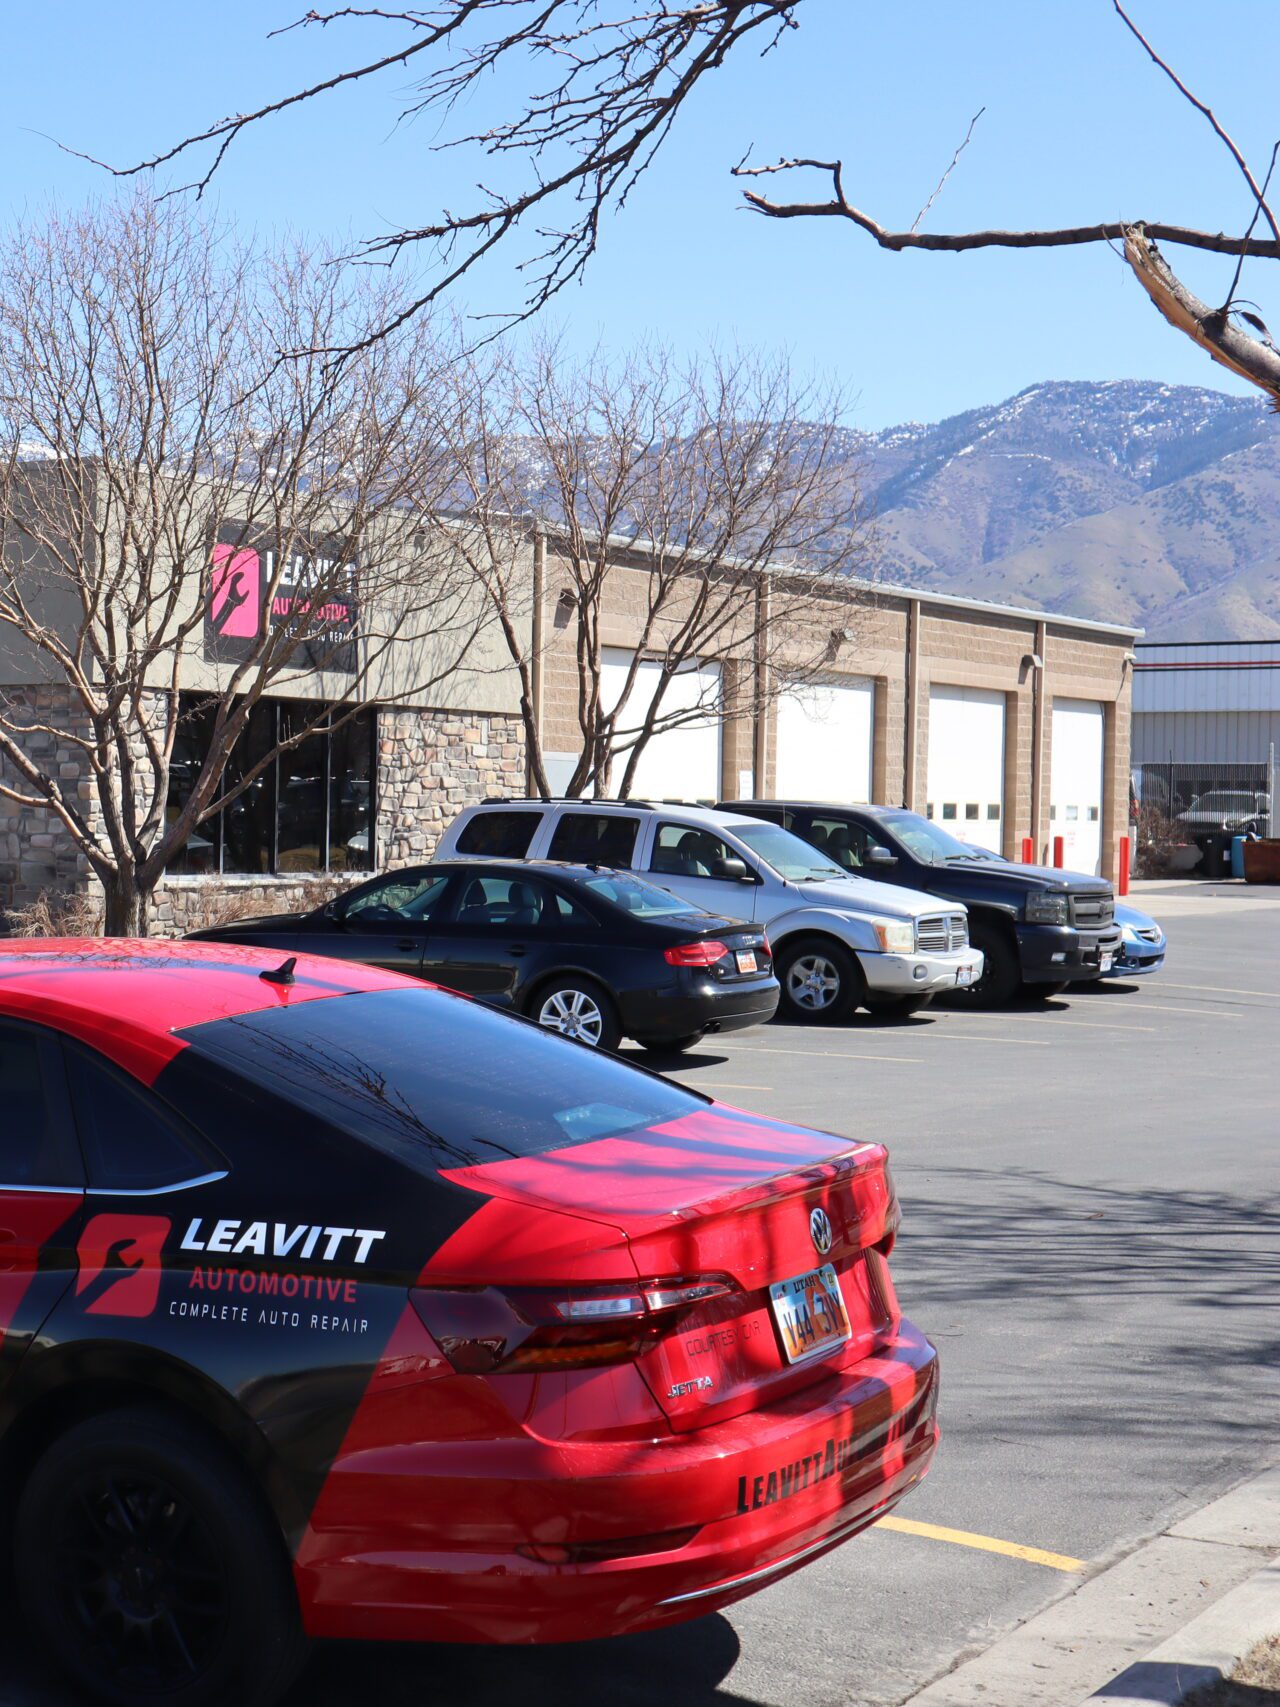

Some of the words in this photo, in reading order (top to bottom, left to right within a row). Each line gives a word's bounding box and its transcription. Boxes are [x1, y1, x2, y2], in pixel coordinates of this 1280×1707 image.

[180, 1217, 386, 1263] LEAVITT
[188, 1266, 358, 1303] AUTOMOTIVE
[793, 1275, 816, 1293] UTAH
[169, 1301, 248, 1322] COMPLETE
[258, 1309, 300, 1328] AUTO
[310, 1314, 369, 1334] REPAIR
[685, 1329, 739, 1356] COURTESY
[742, 1320, 760, 1340] CAR
[667, 1376, 714, 1399] JETTA
